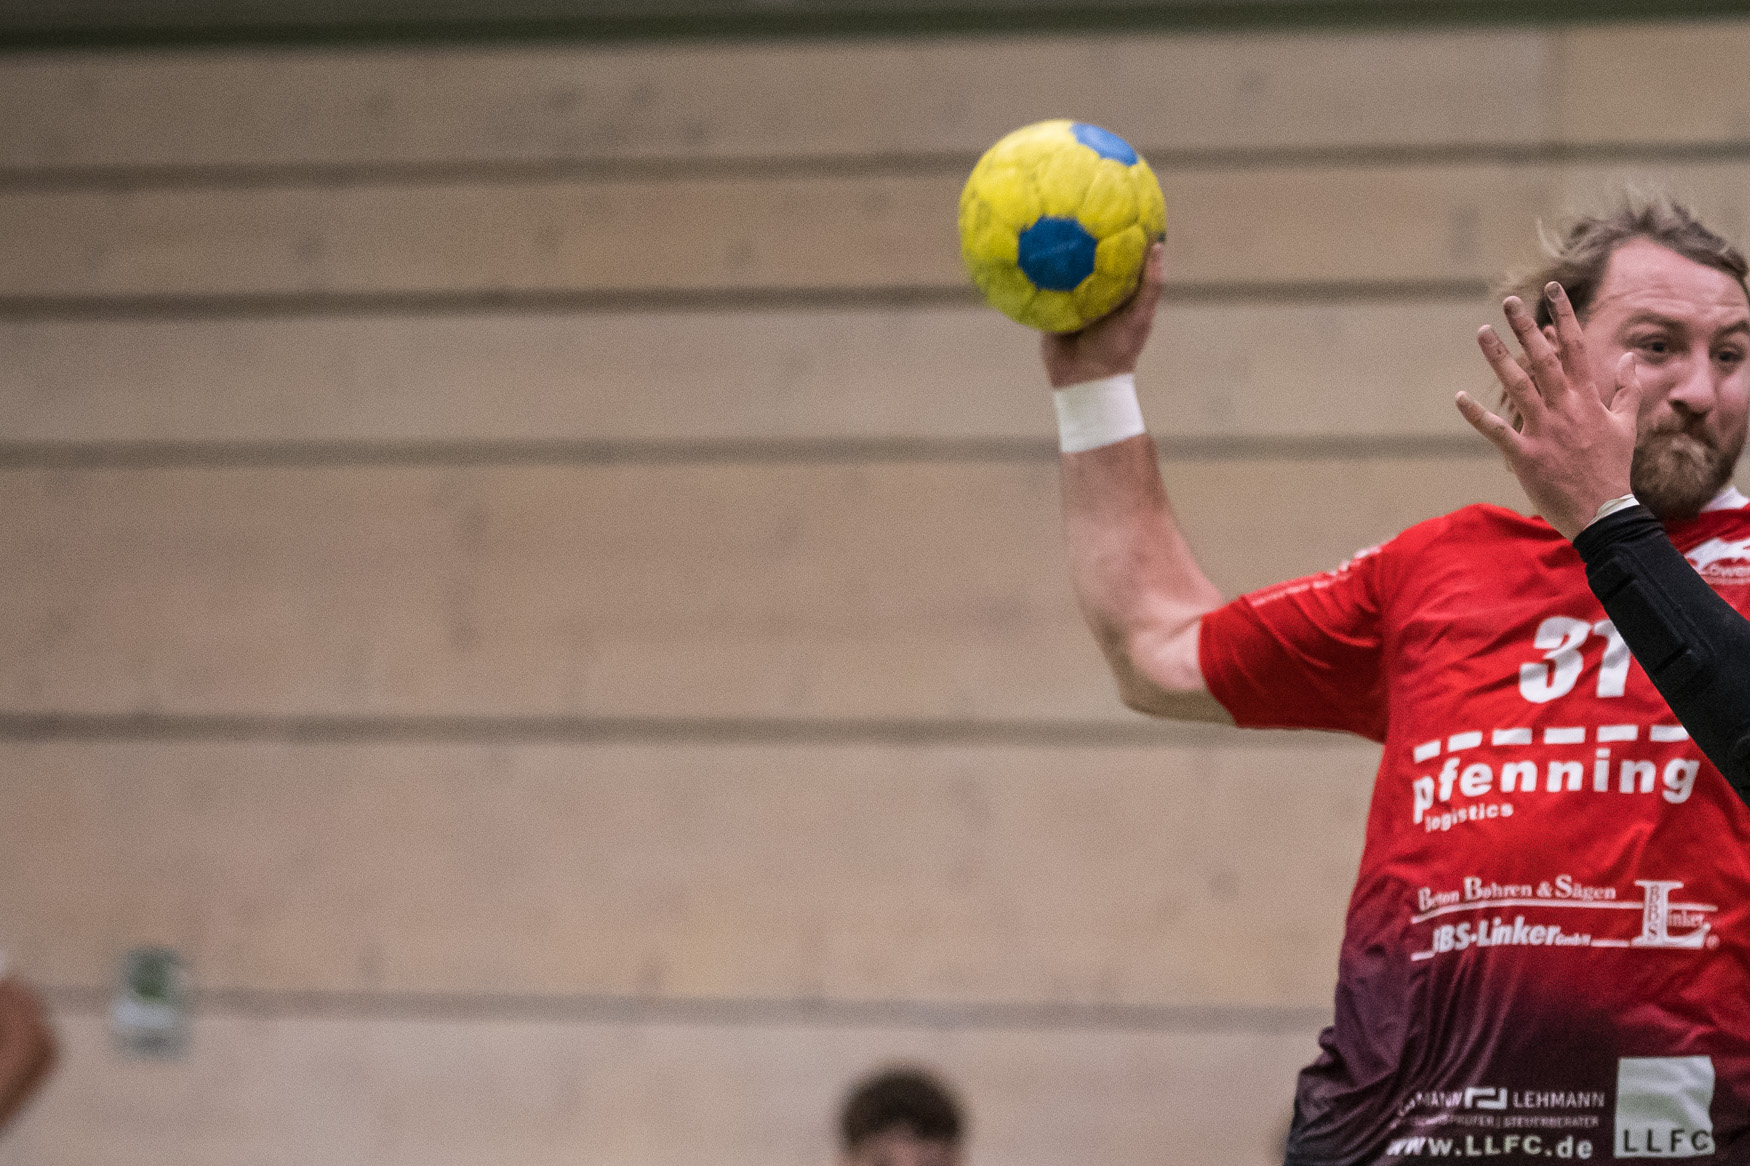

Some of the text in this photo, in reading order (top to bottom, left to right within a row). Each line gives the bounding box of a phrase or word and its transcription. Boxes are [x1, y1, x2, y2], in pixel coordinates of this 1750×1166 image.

[1519, 616, 1631, 703] 31
[1413, 748, 1700, 824] pfenning
[1425, 803, 1514, 832] logistics
[1463, 876, 1532, 900] Bohren
[1537, 881, 1553, 898] &
[1555, 874, 1616, 900] Sägen
[1513, 1091, 1605, 1108] LEHMANN
[1624, 1129, 1710, 1152] LLFC
